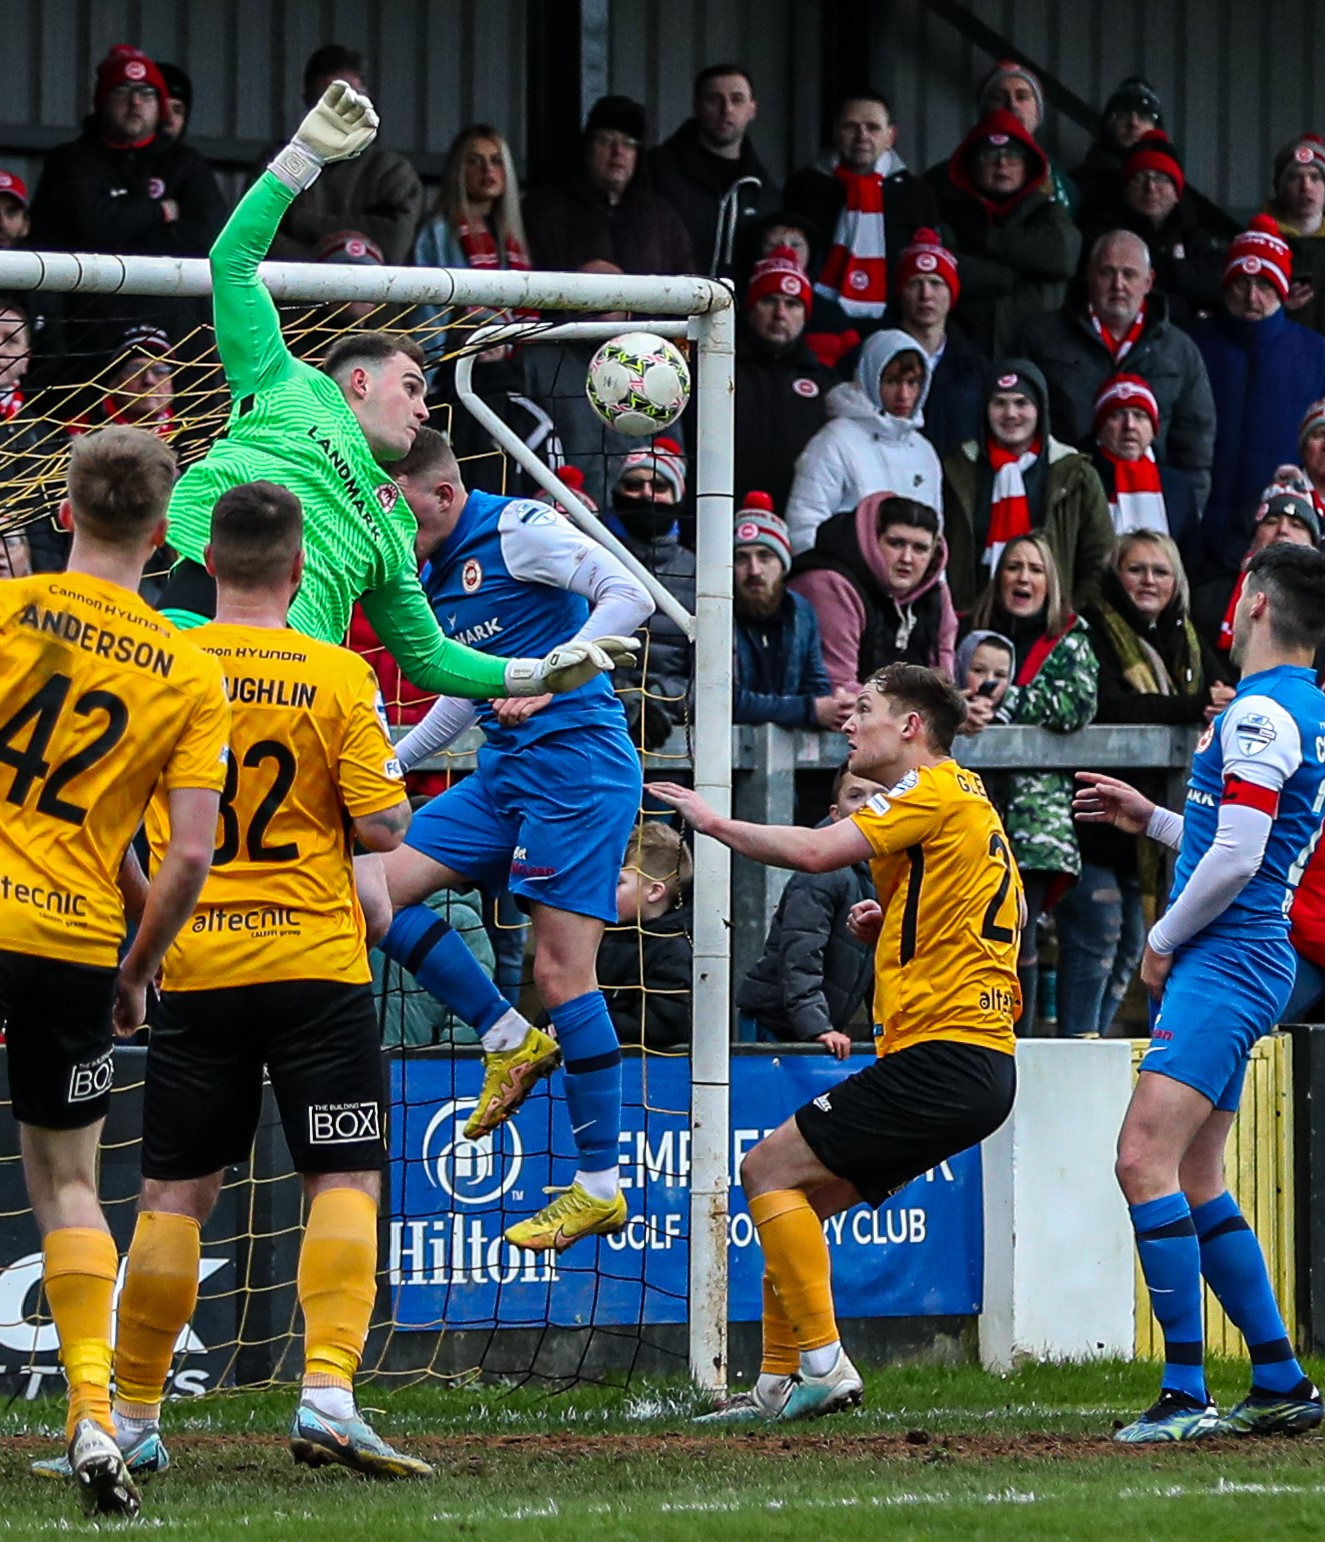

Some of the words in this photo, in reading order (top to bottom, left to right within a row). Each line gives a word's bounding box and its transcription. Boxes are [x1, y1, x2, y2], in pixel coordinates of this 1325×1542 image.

[307, 425, 381, 542] LANDMARK
[48, 584, 102, 611] Cannon
[19, 603, 175, 679] ANDERSON
[235, 648, 307, 663] HYUNDAI
[192, 907, 302, 933] altecnic
[314, 1109, 376, 1139] BOX
[851, 1208, 926, 1245] CLUB
[389, 1212, 560, 1286] Hilton
